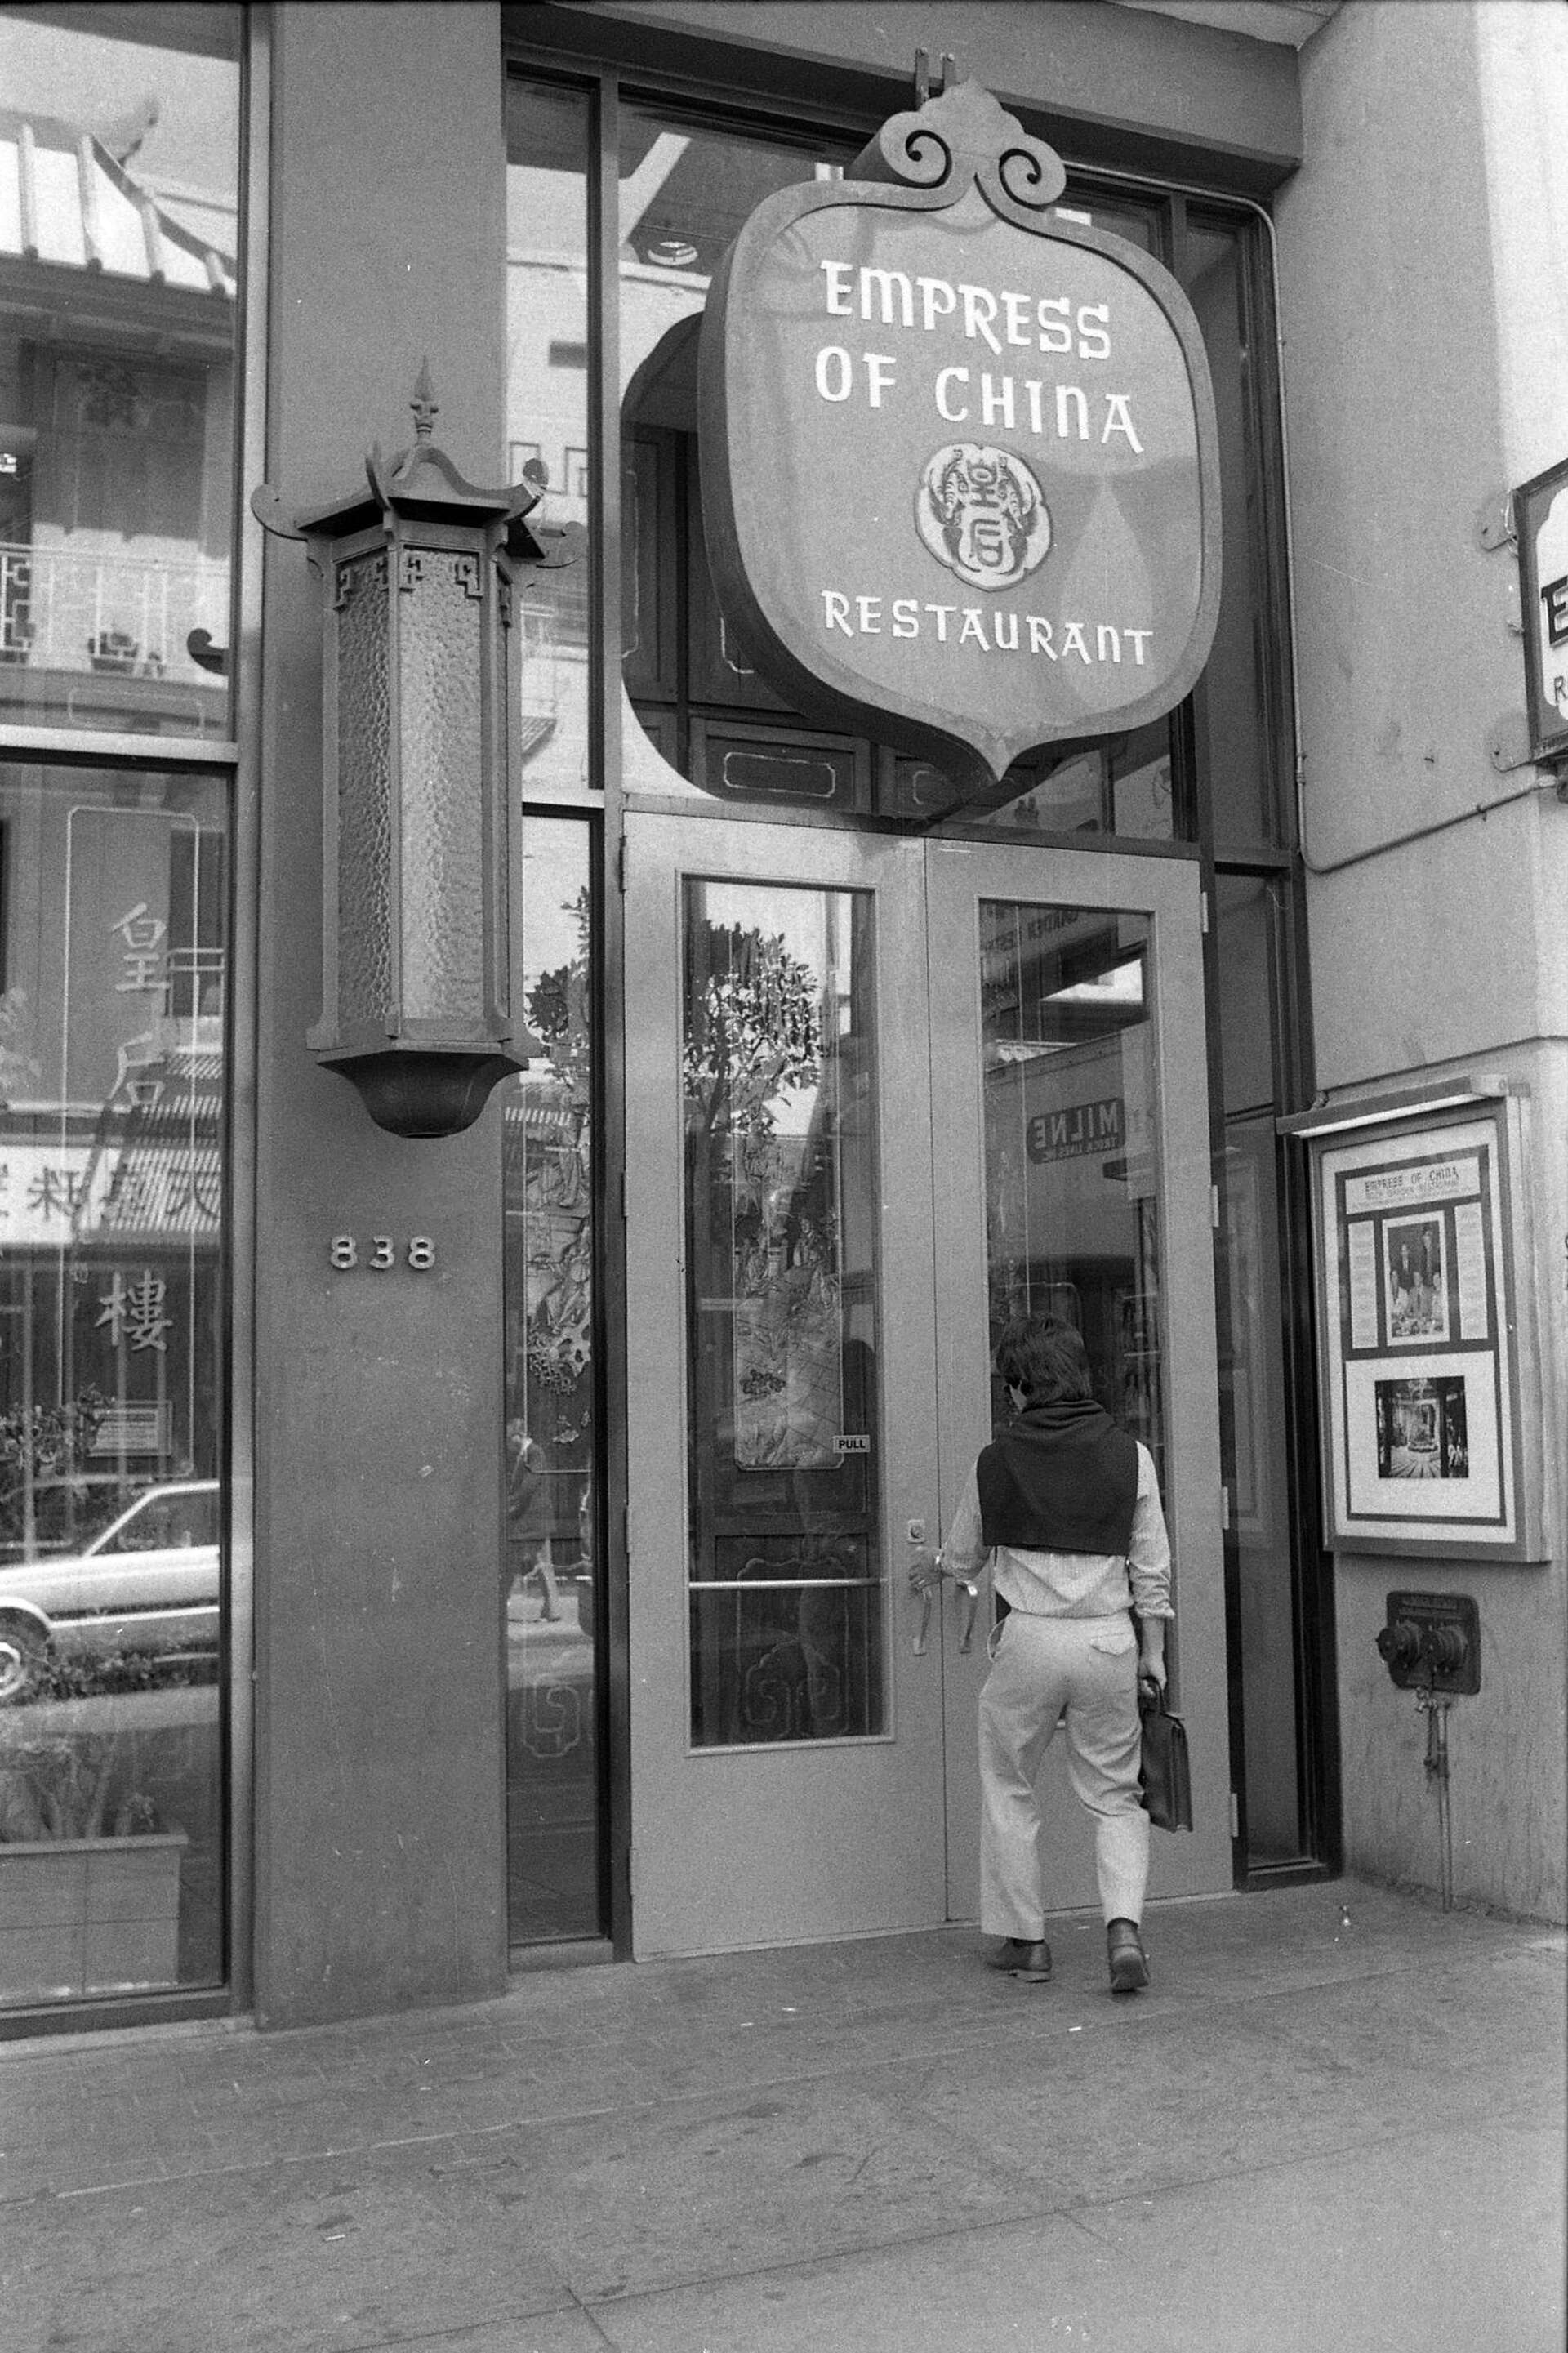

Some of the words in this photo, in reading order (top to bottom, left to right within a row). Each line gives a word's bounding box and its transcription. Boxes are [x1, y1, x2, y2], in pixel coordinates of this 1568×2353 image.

[820, 259, 1111, 359] EMPRESS
[815, 345, 897, 408] OF
[935, 367, 1144, 455] CHINA
[821, 590, 1154, 666] RESTAURANT
[1365, 1175, 1403, 1193] EMPRESS
[1410, 1172, 1422, 1184] OF
[1429, 1166, 1459, 1182] CHINA
[330, 1235, 435, 1269] 838
[839, 1440, 866, 1449] PULL
